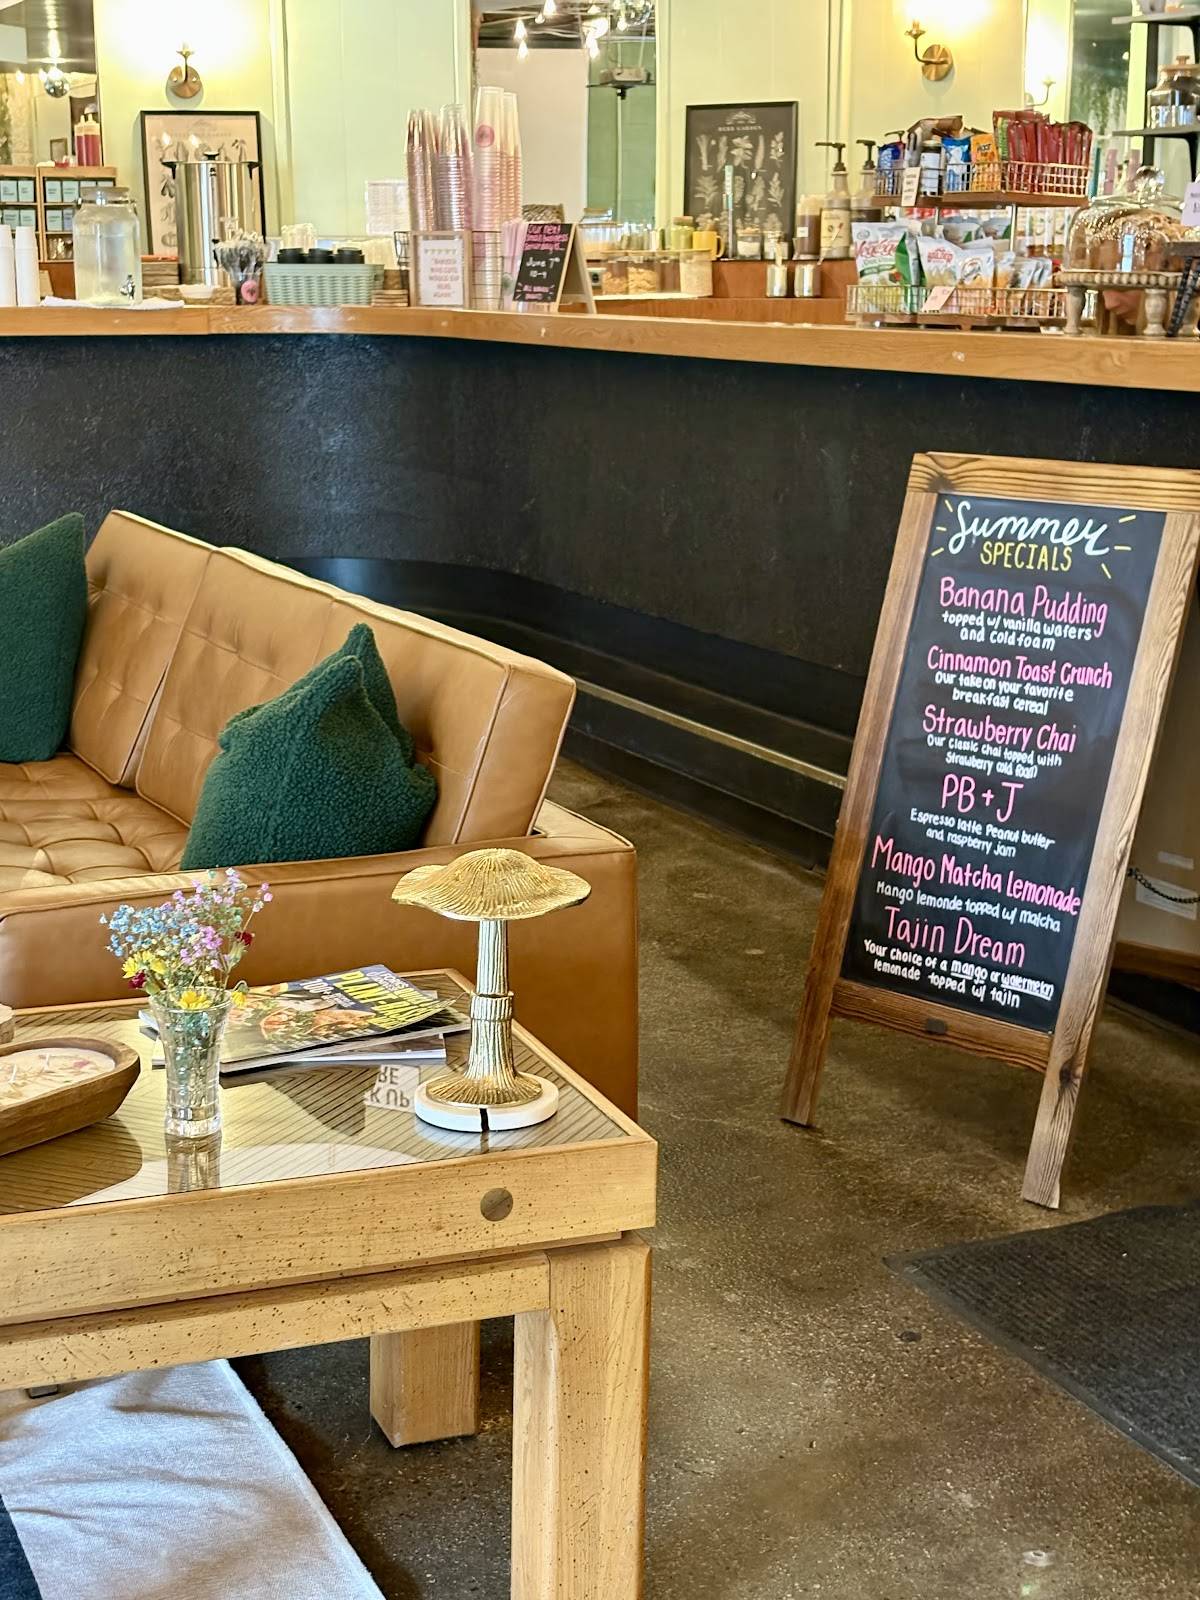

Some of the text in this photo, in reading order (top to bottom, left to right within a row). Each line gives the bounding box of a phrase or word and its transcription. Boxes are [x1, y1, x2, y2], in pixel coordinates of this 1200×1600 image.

[526, 257, 546, 267] June
[949, 501, 1110, 556] Summer
[980, 541, 1073, 571] SPECIALS
[940, 576, 1108, 638] Banana Pudding
[942, 611, 1092, 640] topped w/ vanilla wafers
[960, 626, 985, 642] and
[927, 645, 1113, 689] Cinnamon Toast Crunch
[935, 671, 1074, 702] Our take on your favorite
[952, 687, 1049, 716] breakfast cereal
[923, 704, 1077, 753] Strawberry Chai
[927, 734, 946, 747] Our
[981, 743, 1002, 757] chai
[1004, 747, 1034, 765] topped
[1037, 754, 1062, 767] with
[941, 773, 1024, 823] PB + J
[910, 808, 956, 827] Espresso
[957, 818, 983, 834] latte
[1021, 830, 1056, 850] butter
[926, 827, 1017, 858] and raspberry jam
[871, 835, 1081, 916] Mango Matcha Lemonade
[876, 881, 914, 904] Mango
[964, 898, 1000, 918] topped
[1001, 907, 1017, 925] w/
[1019, 910, 1061, 932] matcha
[884, 905, 1026, 968] Tajin Dream
[863, 939, 888, 957] Your
[924, 955, 938, 969] of
[940, 960, 948, 971] a
[951, 960, 988, 982] mango
[990, 971, 1001, 983] or
[1001, 973, 1055, 999] watermelon
[873, 959, 1021, 1009] lemonade topped w/ tajin
